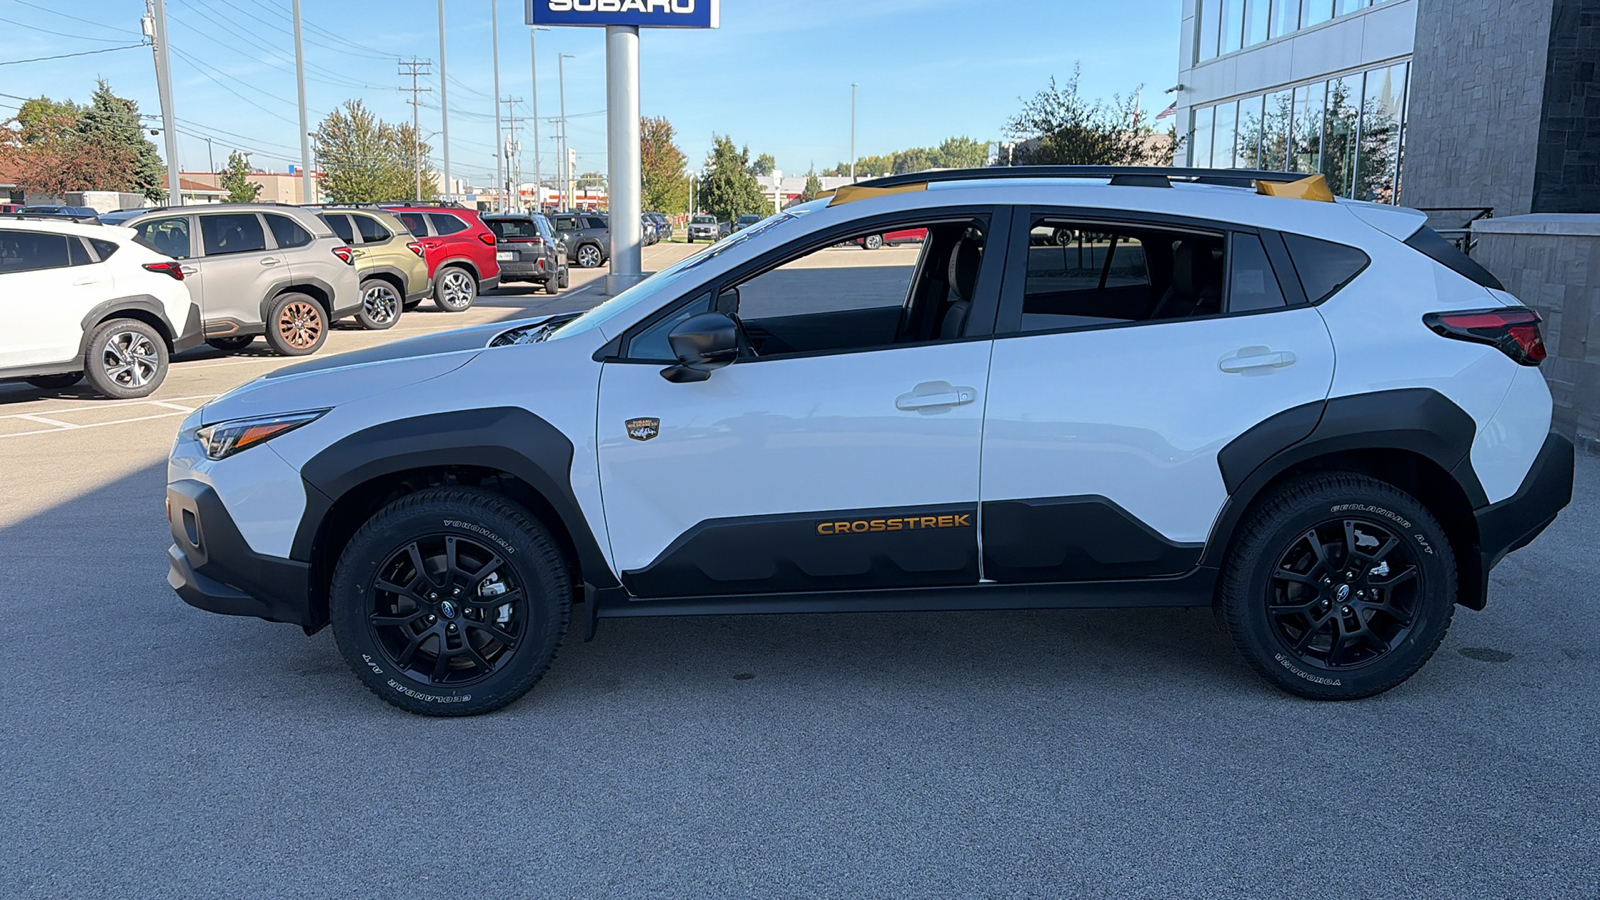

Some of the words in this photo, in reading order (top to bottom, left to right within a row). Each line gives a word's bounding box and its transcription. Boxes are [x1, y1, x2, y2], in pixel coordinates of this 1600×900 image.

[548, 0, 695, 13] SUBARU
[443, 519, 515, 554] YOKOHAMA
[817, 514, 970, 535] CROSSTREK
[1330, 503, 1412, 529] GEOLANDAR
[1414, 533, 1433, 554] A/T
[362, 653, 384, 674] A/T
[1274, 652, 1342, 686] YOKOHAMA
[387, 679, 472, 703] GEOLANDAR
